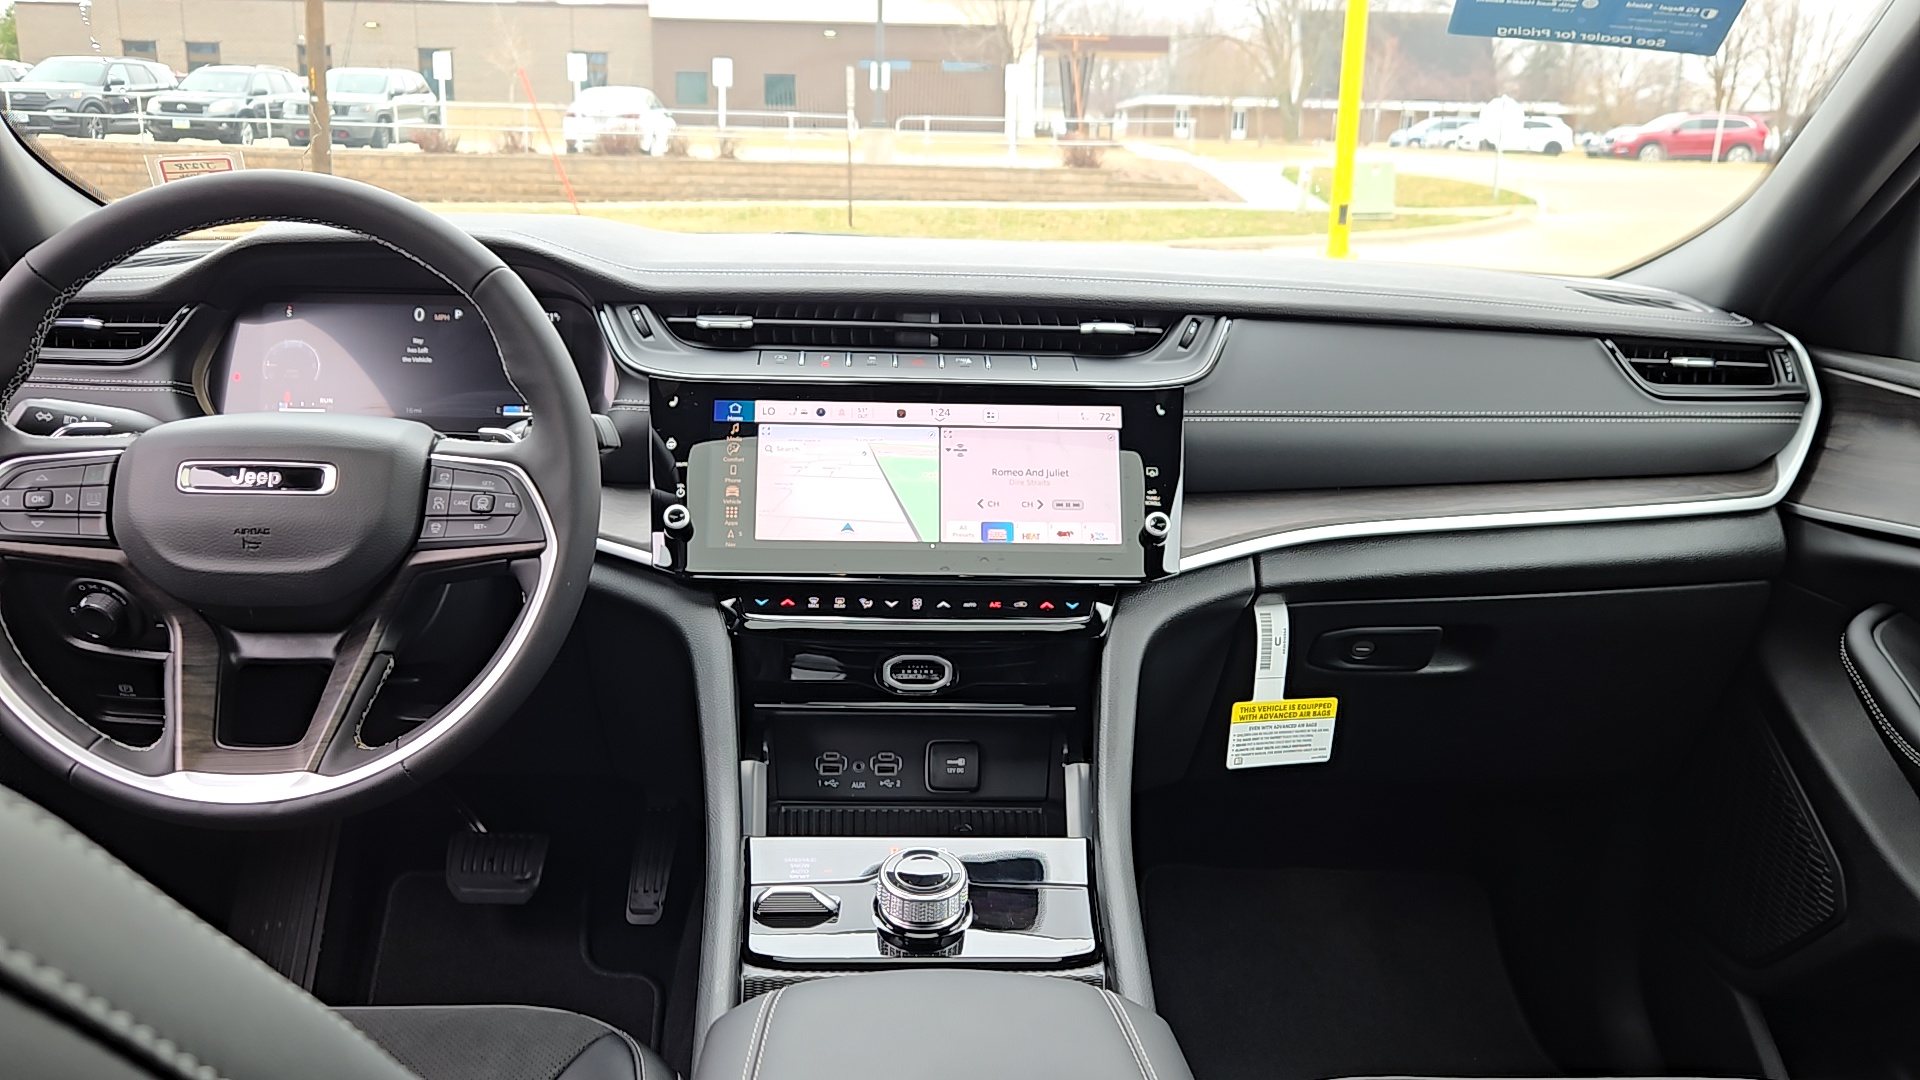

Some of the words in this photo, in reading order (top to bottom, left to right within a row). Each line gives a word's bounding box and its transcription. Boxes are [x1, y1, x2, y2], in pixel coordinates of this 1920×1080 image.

[414, 308, 425, 322] 0
[454, 309, 463, 319] P
[763, 407, 775, 415] LO
[930, 408, 950, 417] 1:24
[1099, 413, 1116, 421] 72°
[230, 468, 282, 487] Jeep
[992, 468, 1023, 477] Romeo
[1025, 469, 1044, 477] And
[1046, 469, 1069, 478] Juliet
[31, 495, 45, 503] OK
